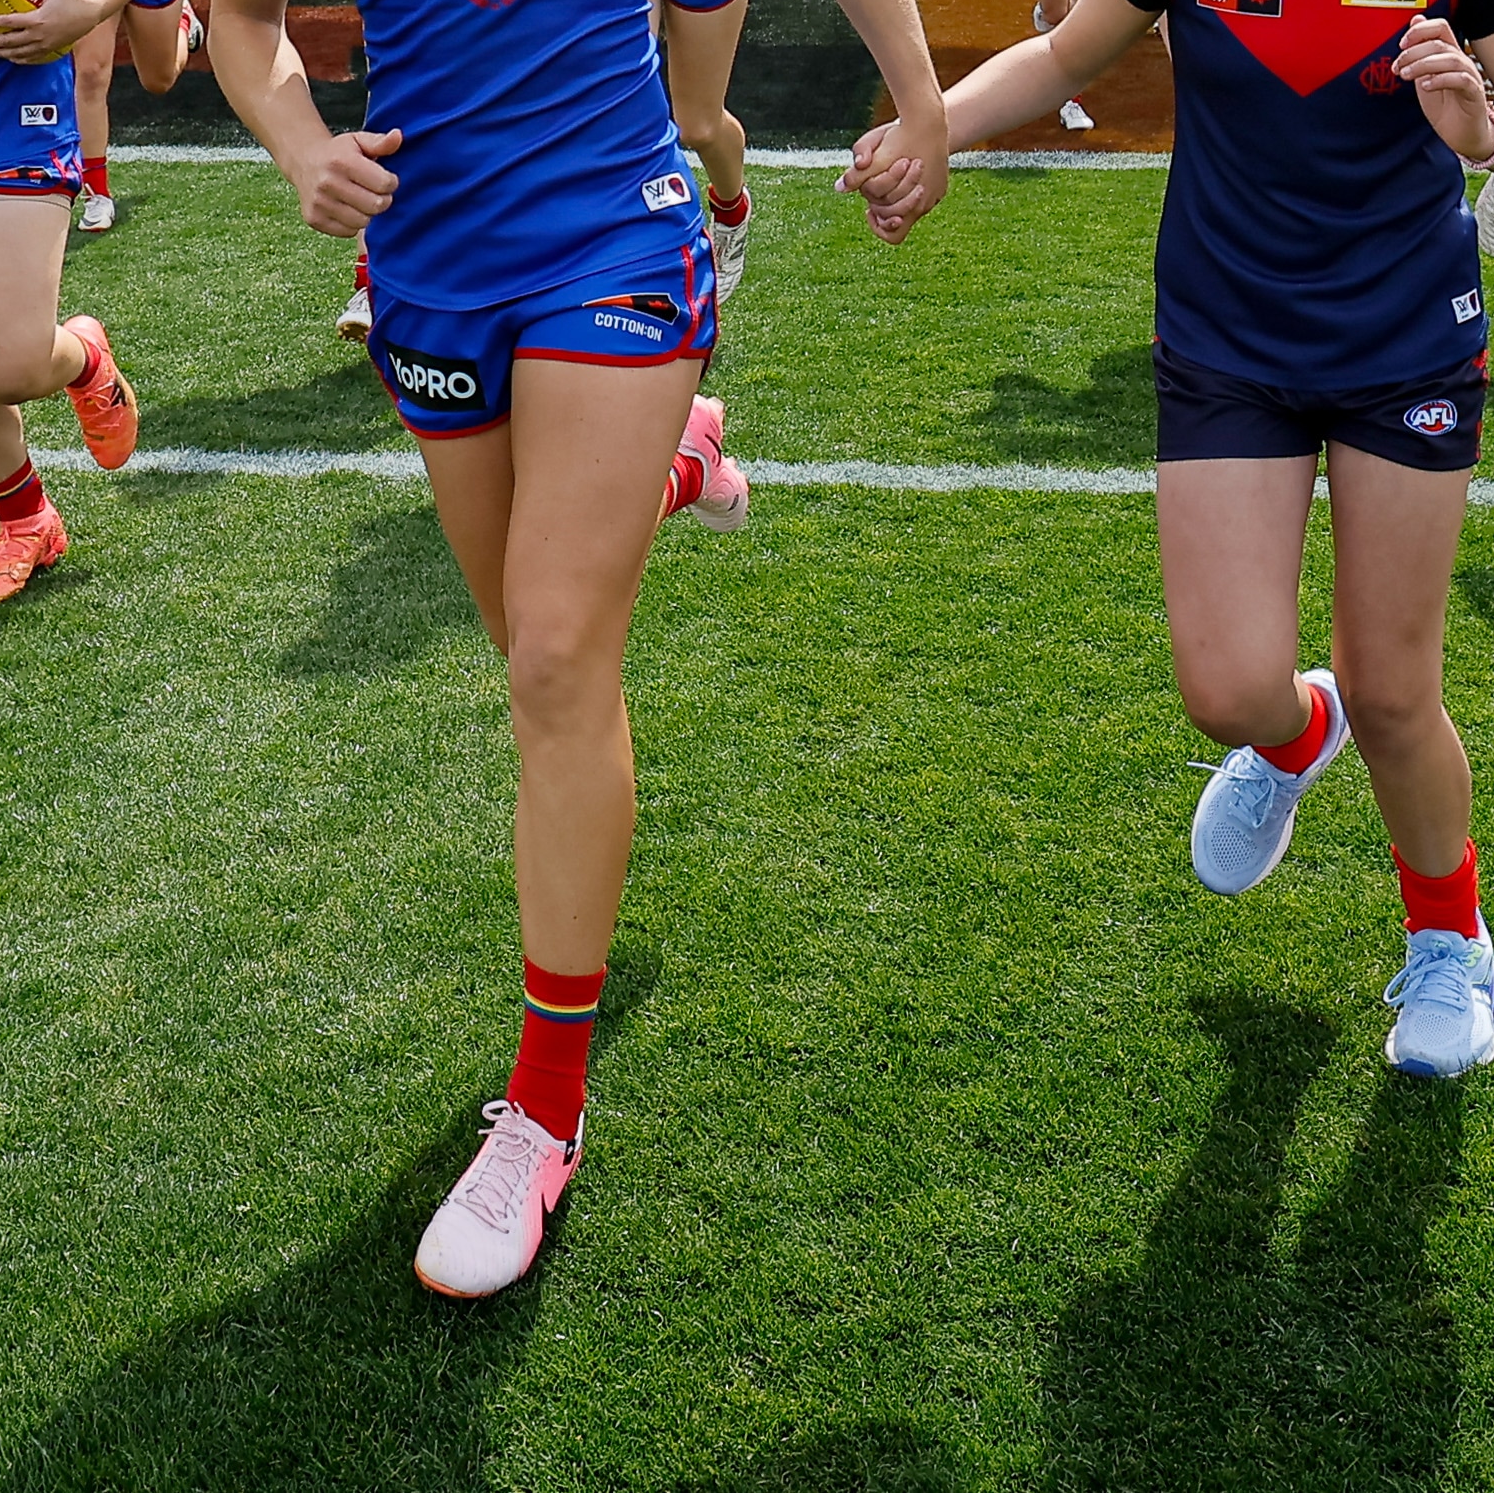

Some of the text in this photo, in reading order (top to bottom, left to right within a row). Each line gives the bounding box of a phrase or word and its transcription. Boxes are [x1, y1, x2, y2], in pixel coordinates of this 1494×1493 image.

[594, 312, 663, 343] COTTON:ON
[388, 352, 477, 400] YoPRO
[1411, 407, 1454, 426] AFL
